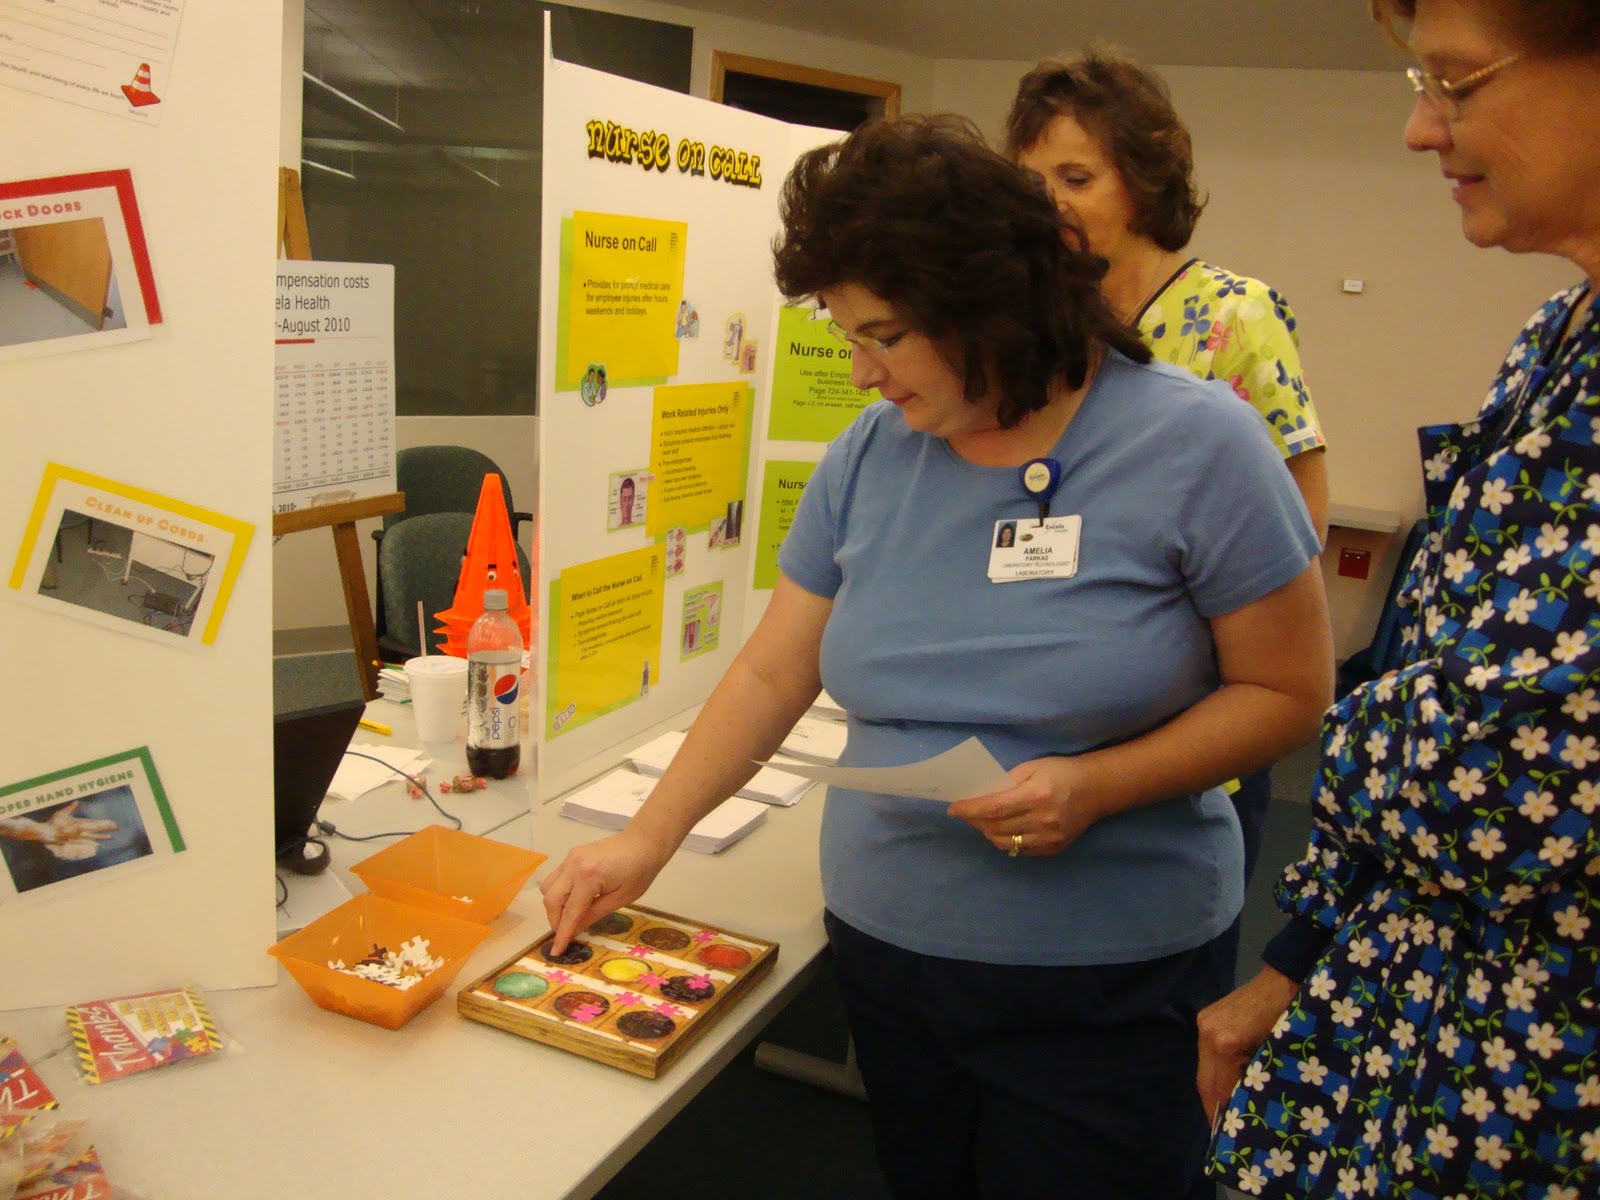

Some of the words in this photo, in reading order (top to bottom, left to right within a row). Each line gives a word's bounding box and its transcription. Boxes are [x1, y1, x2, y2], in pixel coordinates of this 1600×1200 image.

[26, 201, 83, 217] DOORS
[585, 230, 619, 250] Nurse
[622, 238, 636, 251] on
[638, 236, 657, 252] Call
[276, 274, 340, 291] mpensation
[343, 275, 370, 290] costs
[587, 279, 611, 289] Provides
[612, 281, 620, 289] for
[620, 281, 638, 290] prompt
[640, 282, 658, 290] medical
[295, 295, 330, 310] Health
[586, 293, 594, 302] for
[595, 294, 622, 304] employee
[622, 294, 641, 304] injuries
[642, 294, 653, 302] after
[585, 307, 614, 315] weekends
[614, 307, 624, 315] and
[324, 317, 350, 332] 2010
[790, 342, 834, 358] Nurse
[814, 370, 828, 378] after
[817, 378, 845, 386] business
[809, 386, 826, 396] Page
[661, 409, 676, 419] Work
[676, 408, 696, 418] Related
[698, 406, 717, 418] Injuries
[718, 405, 730, 415] Only
[278, 503, 297, 514] 2010-
[85, 496, 132, 520] CLEAN
[158, 519, 205, 543] CORDS
[1023, 546, 1052, 555] AMELIA
[572, 592, 586, 602] When
[592, 586, 602, 595] Call
[603, 584, 611, 592] the
[612, 580, 626, 589] Nurse
[633, 574, 642, 583] Call
[604, 600, 612, 609] Call
[492, 707, 502, 740] pepsi
[36, 787, 74, 804] HAND
[78, 770, 134, 792] HYGIENE
[78, 1006, 146, 1072] Thanks
